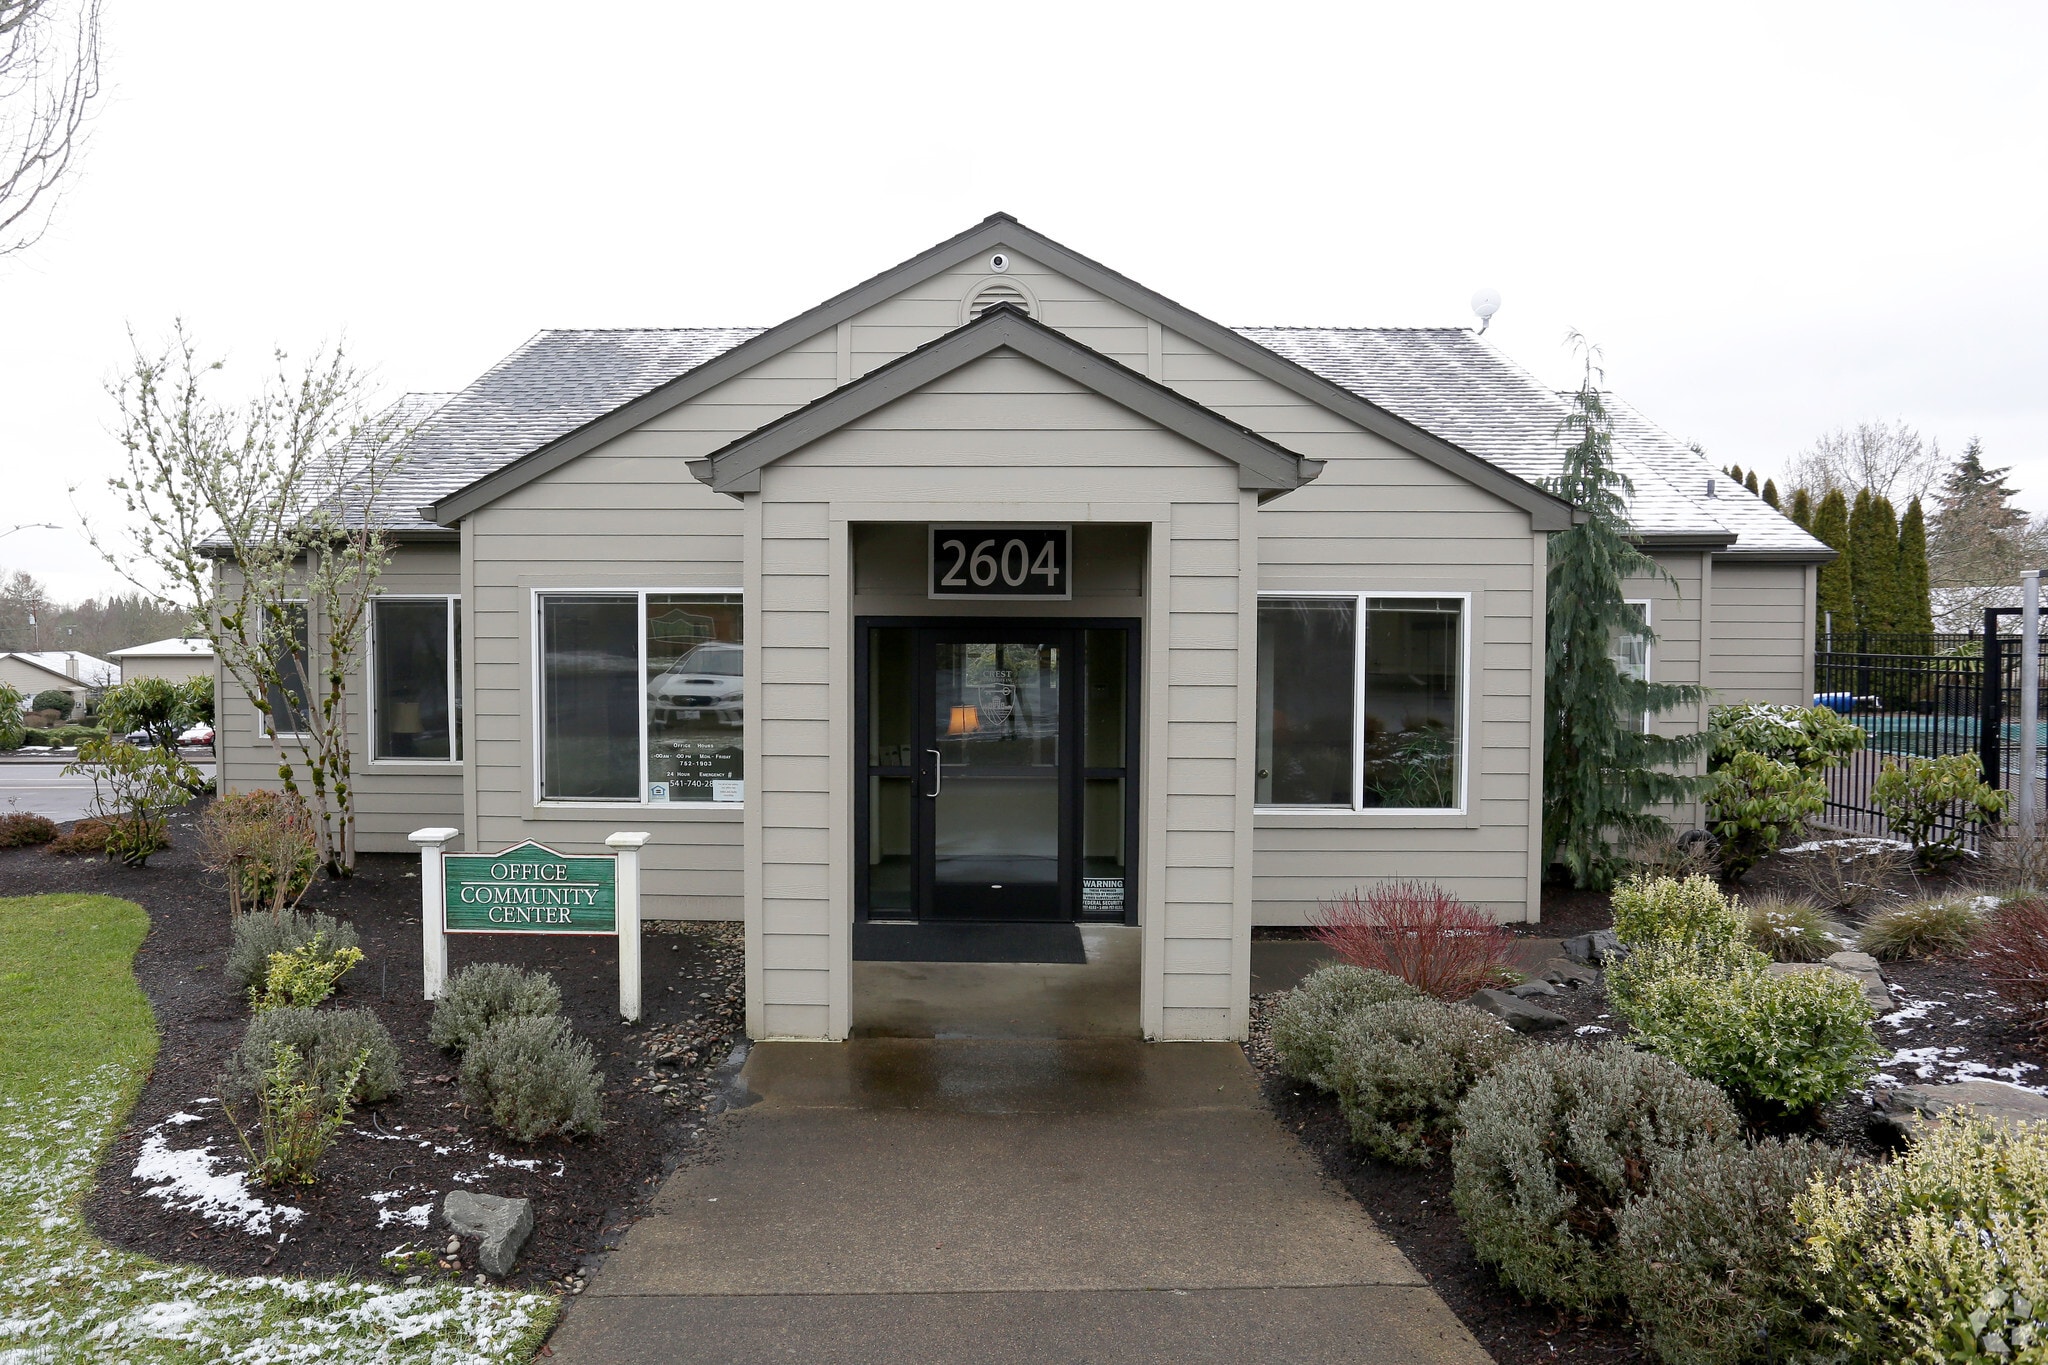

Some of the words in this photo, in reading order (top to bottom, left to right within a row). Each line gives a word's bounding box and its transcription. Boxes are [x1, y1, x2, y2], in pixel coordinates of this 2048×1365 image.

[940, 538, 1060, 587] 2604
[982, 670, 1012, 678] CREST
[490, 862, 568, 881] OFFICE
[1083, 880, 1123, 888] WARNING
[460, 886, 600, 905] COMMUNITY
[488, 906, 573, 924] CENTER
